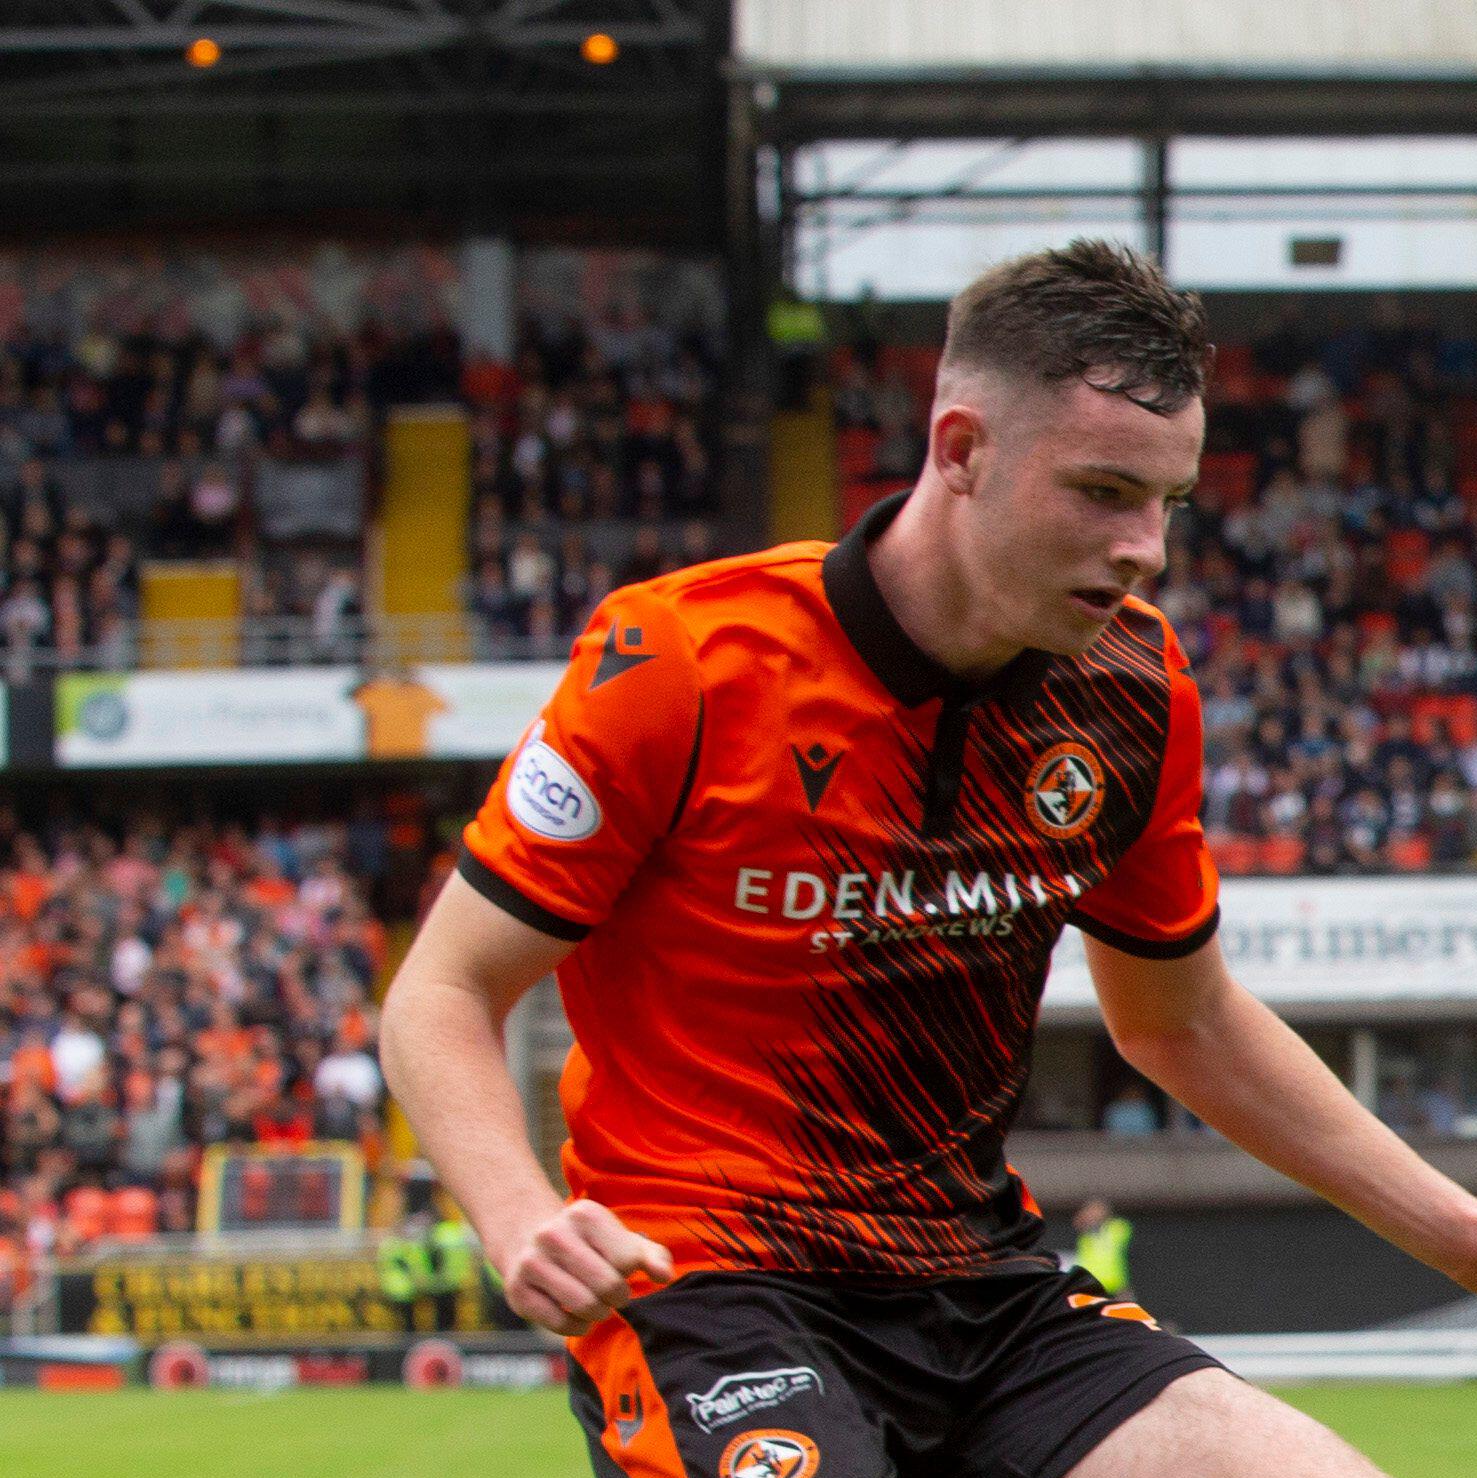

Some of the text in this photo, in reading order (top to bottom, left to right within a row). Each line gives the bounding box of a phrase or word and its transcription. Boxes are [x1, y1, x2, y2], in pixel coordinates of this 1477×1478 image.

[516, 757, 582, 819] inch
[809, 912, 1016, 955] ST ANDREWS
